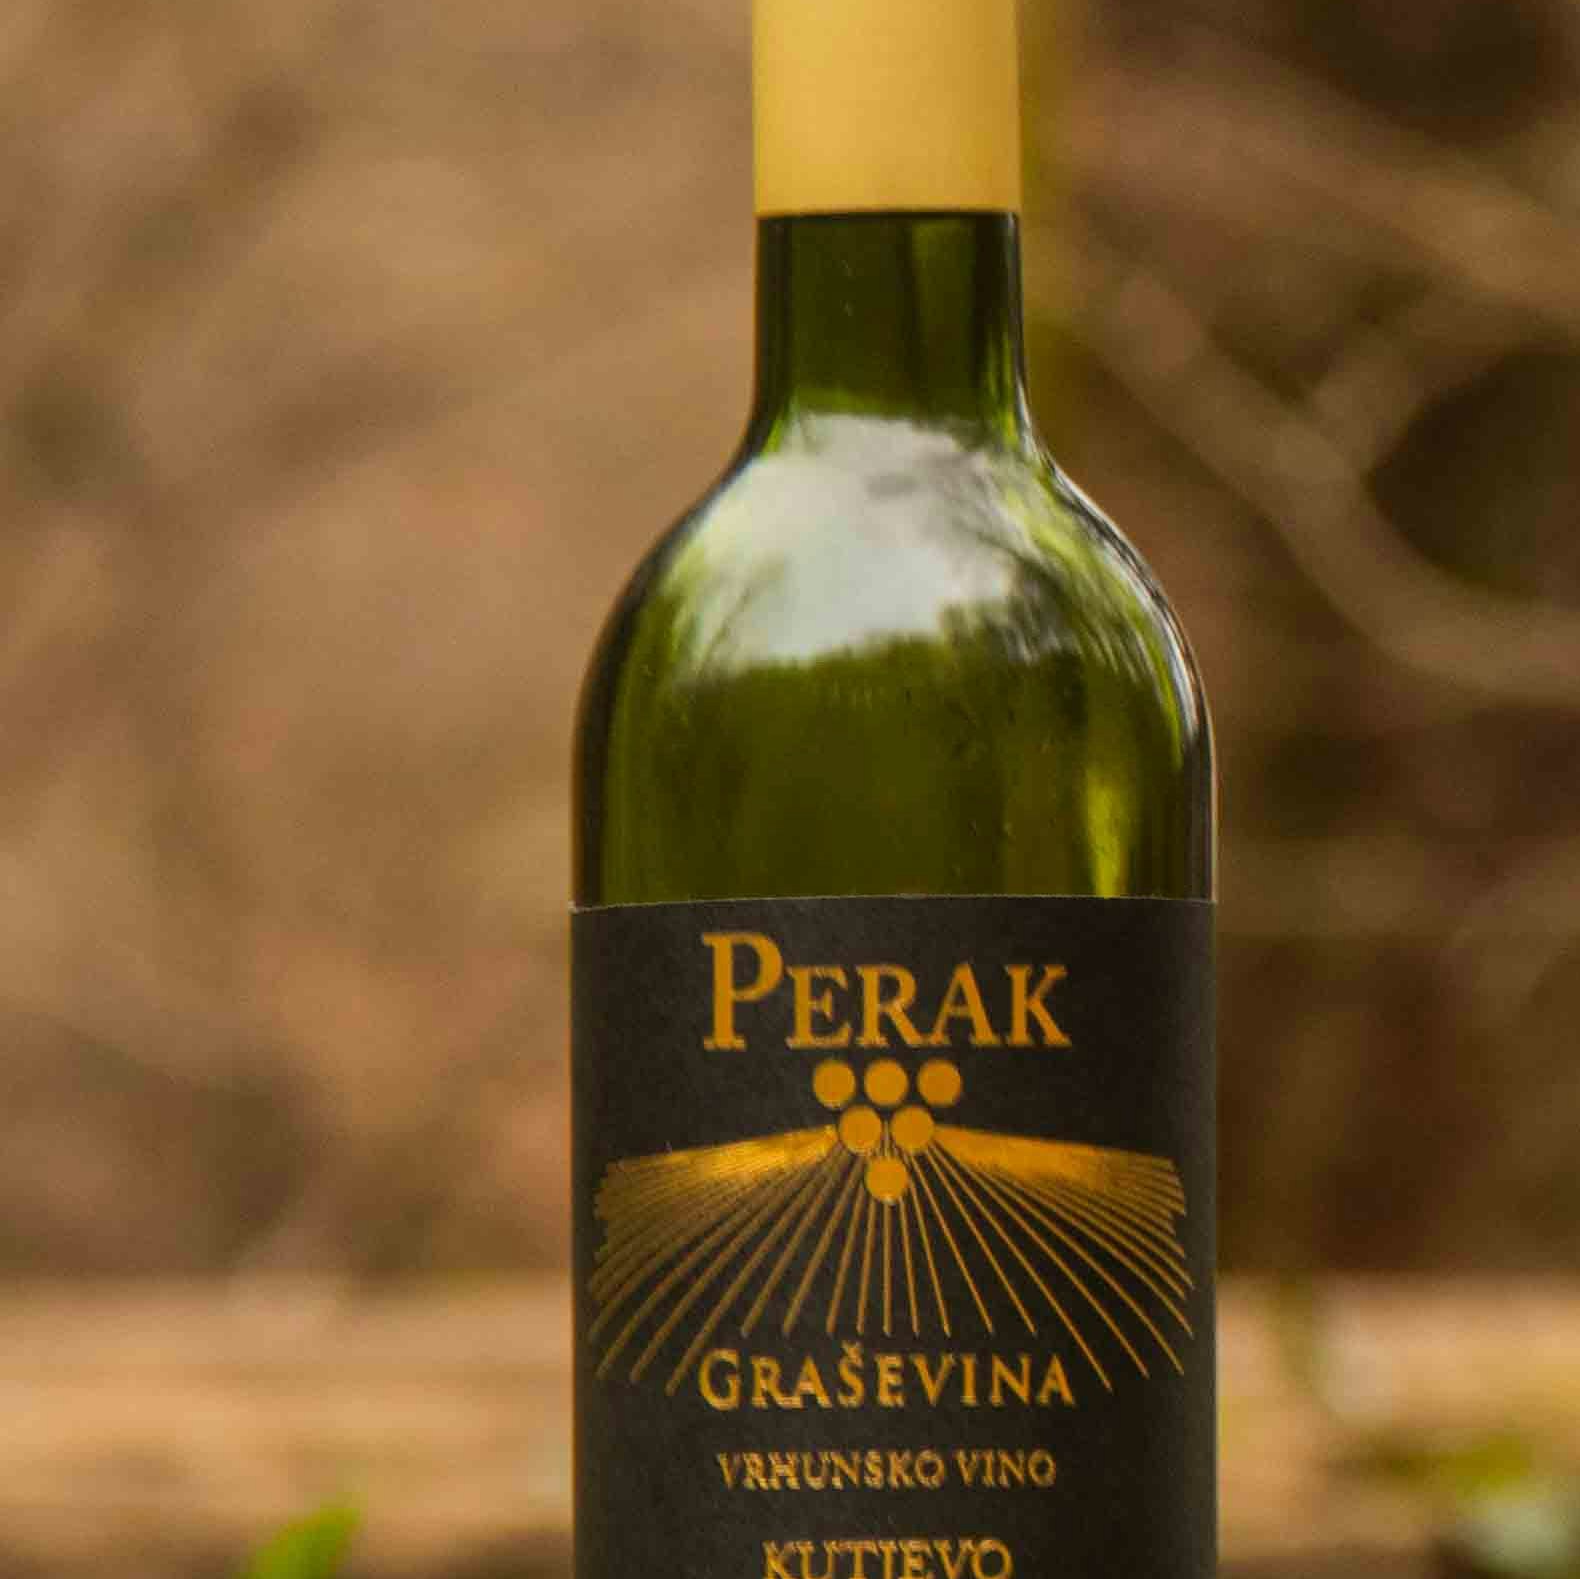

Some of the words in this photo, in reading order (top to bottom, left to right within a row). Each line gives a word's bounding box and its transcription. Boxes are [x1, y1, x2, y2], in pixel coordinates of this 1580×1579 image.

[702, 931, 1073, 1051] PERAK
[699, 1339, 1077, 1411] GRAŠEVINA
[717, 1450, 944, 1491] VRHUNSKO
[953, 1448, 1058, 1489] VINO
